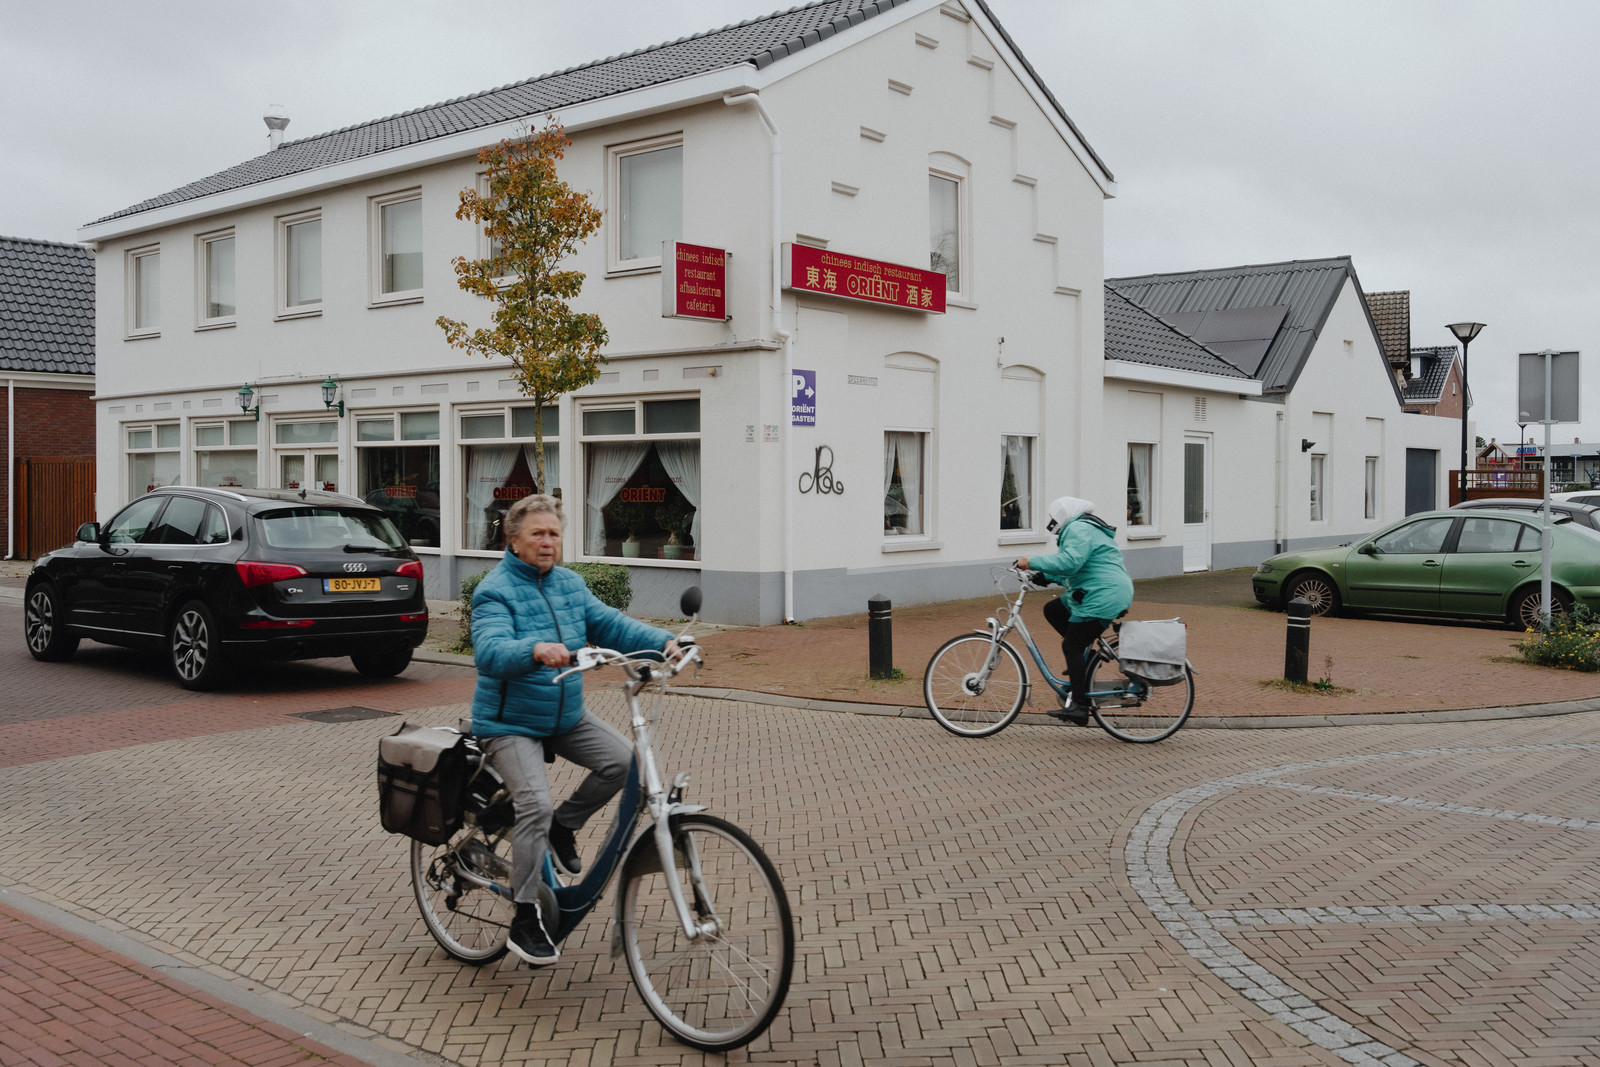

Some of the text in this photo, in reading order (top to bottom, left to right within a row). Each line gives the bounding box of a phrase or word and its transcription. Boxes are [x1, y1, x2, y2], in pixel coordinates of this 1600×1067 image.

[676, 248, 724, 267] chinees indisch
[684, 268, 716, 281] restaurant
[821, 253, 922, 282] chinees indisch restaurant
[680, 281, 722, 298] afhaalcentrum
[806, 266, 933, 307] 東海 ORIËNT 酒家
[686, 298, 716, 312] cafetaria
[792, 375, 806, 398] P
[792, 403, 815, 413] ORIËNT
[792, 415, 815, 423] GASTEN
[621, 485, 665, 502] ORIËNT
[334, 579, 376, 590] 80-JVJ-7
